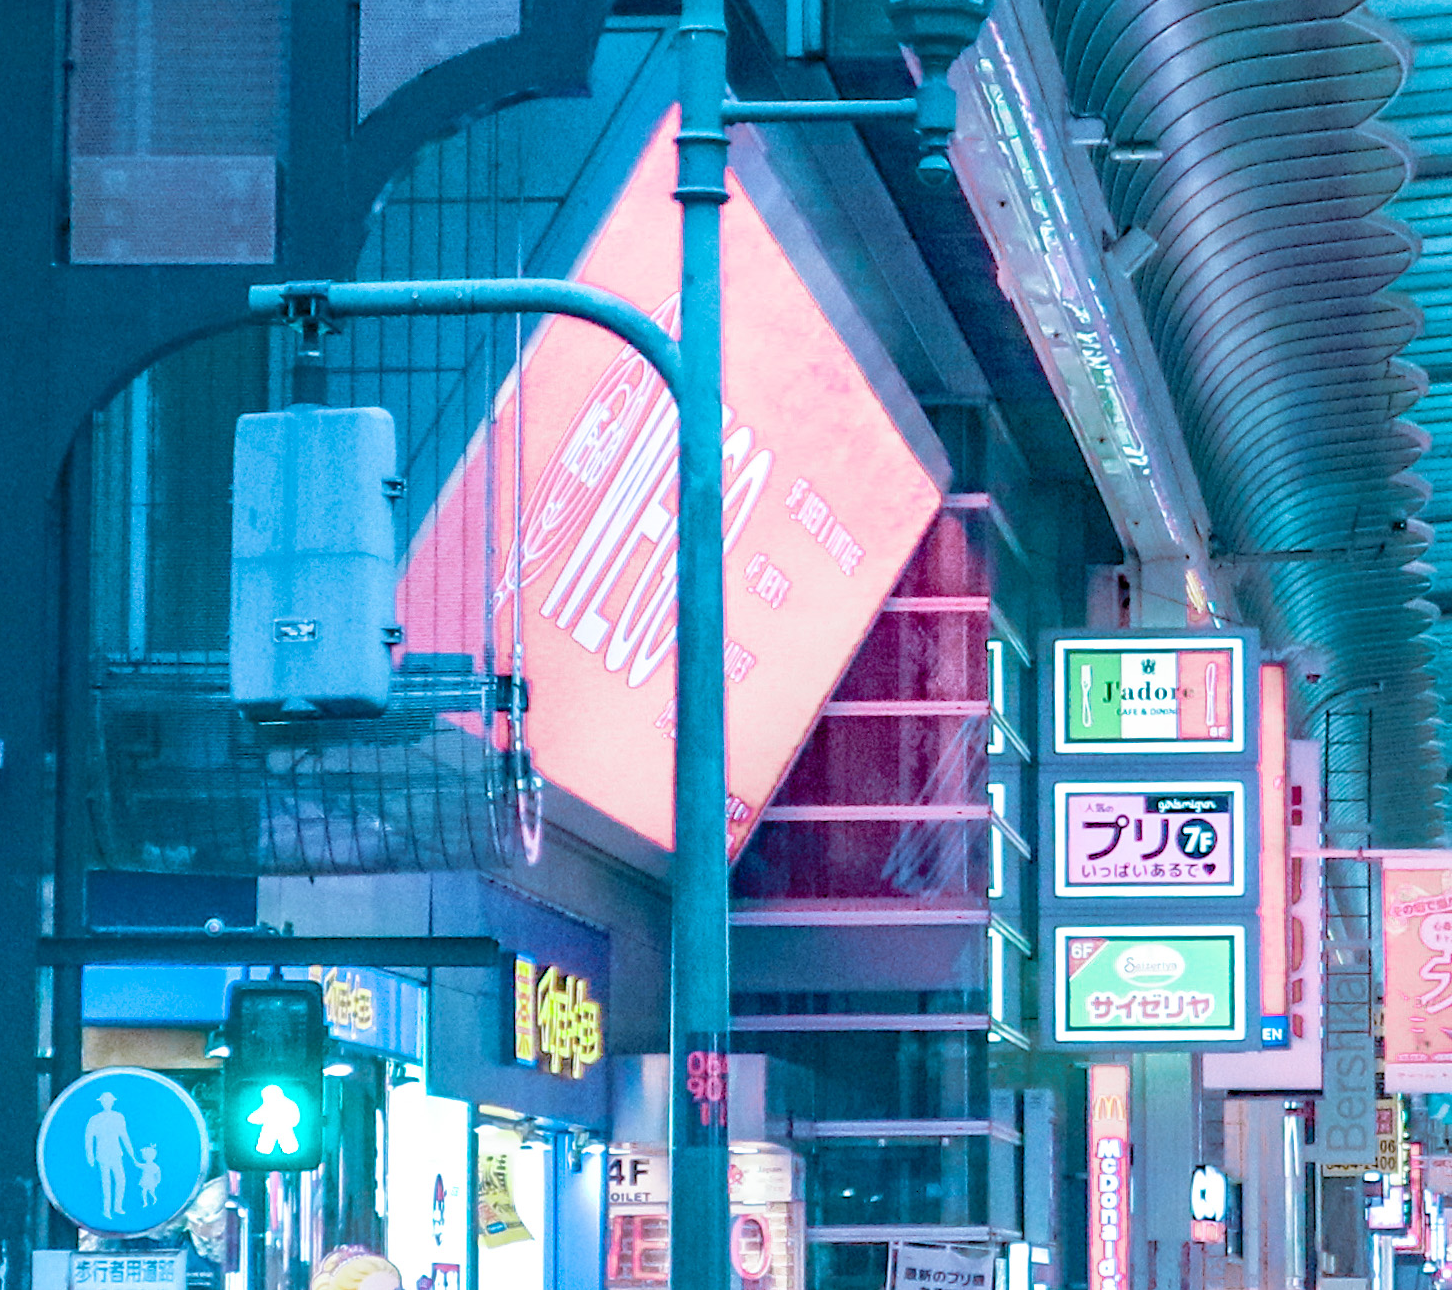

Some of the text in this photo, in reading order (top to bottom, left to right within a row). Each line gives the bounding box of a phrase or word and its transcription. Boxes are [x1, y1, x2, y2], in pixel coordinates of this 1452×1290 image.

[1102, 681, 1194, 703] J'adore
[1083, 815, 1170, 860] プリ
[1181, 826, 1214, 854] 7F
[1082, 862, 1198, 878] いっぱいあるで
[1071, 944, 1094, 959] 6F
[1091, 994, 1211, 1019] サイゼリヤ
[1326, 977, 1367, 1152] Bershka
